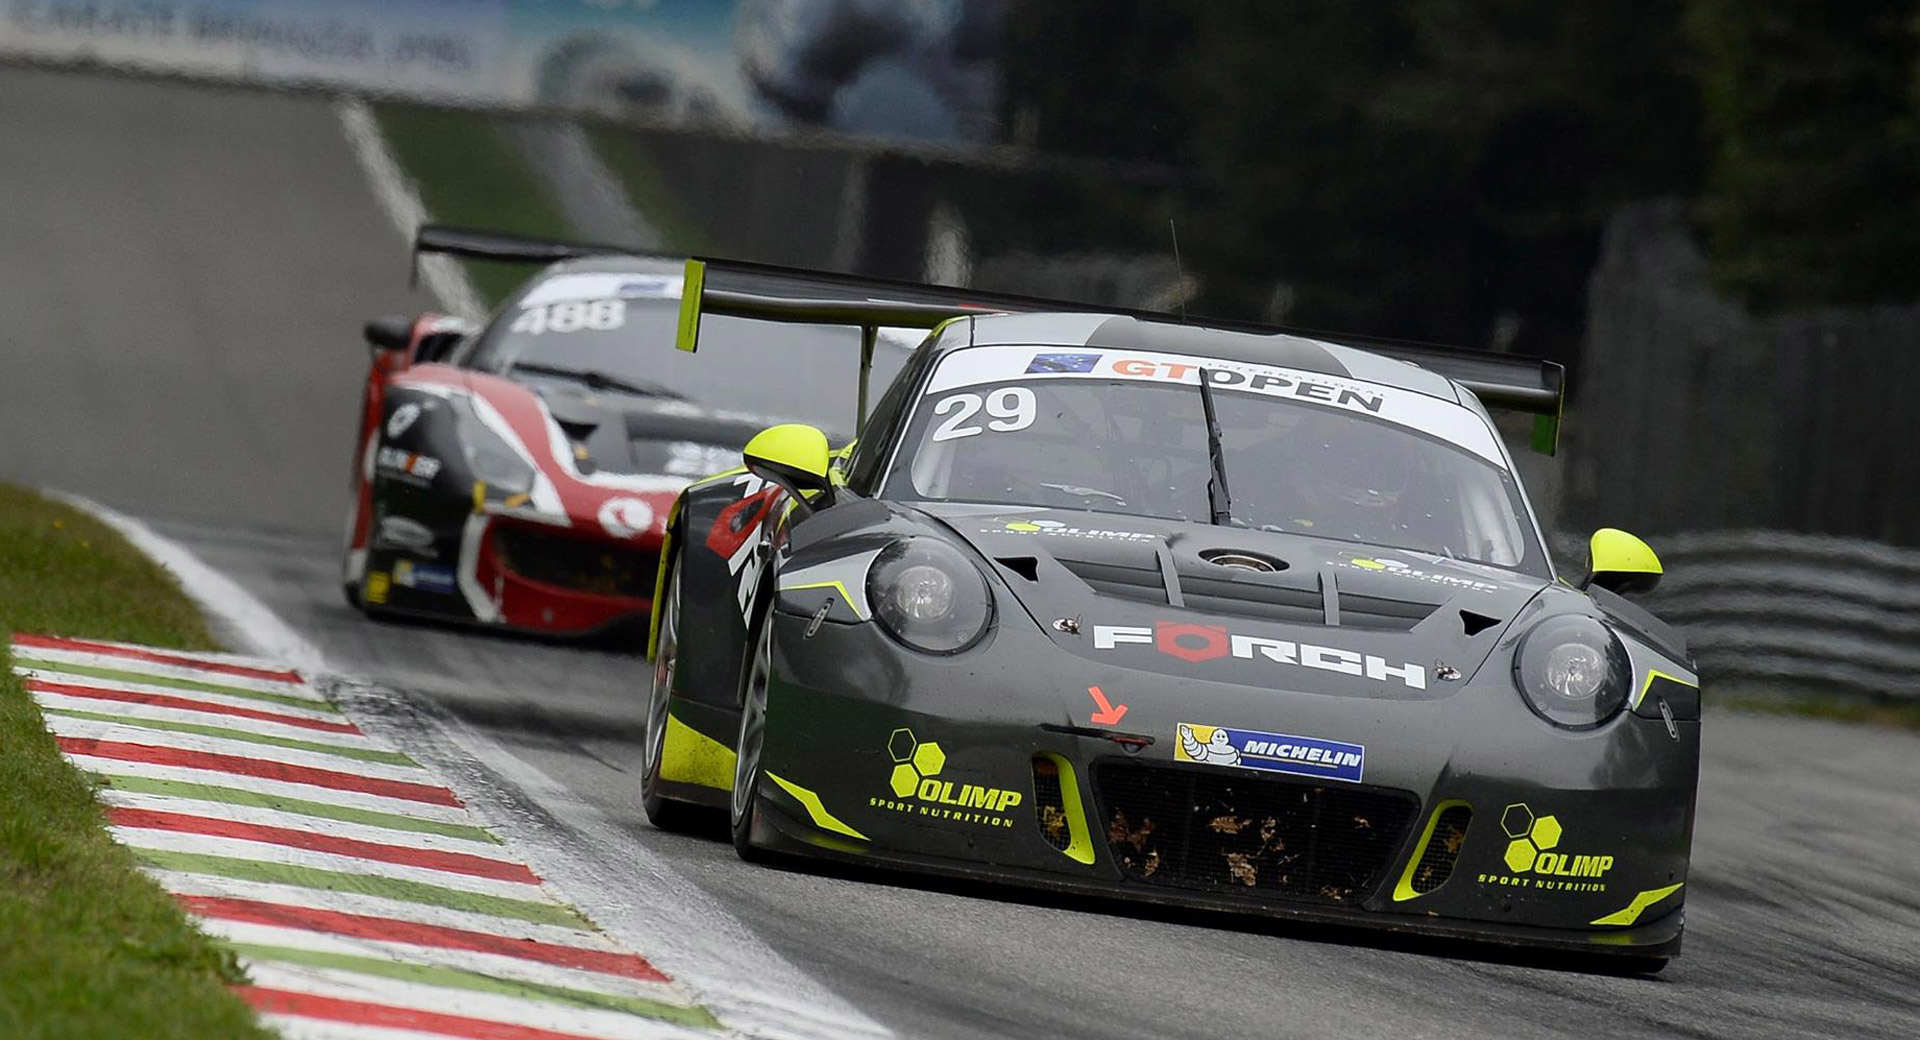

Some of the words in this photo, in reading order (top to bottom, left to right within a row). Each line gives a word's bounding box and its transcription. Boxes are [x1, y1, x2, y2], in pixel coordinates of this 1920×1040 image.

[510, 299, 626, 336] 488
[933, 387, 1037, 441] 29
[1042, 527, 1157, 540] OLIMP
[1387, 566, 1499, 590] OLIMP
[1243, 739, 1362, 768] MICHELIN
[917, 778, 1023, 813] OLIMP
[869, 796, 915, 814] SPORT
[919, 805, 1014, 829] NUTRITION
[1533, 851, 1615, 878] OLIMP
[1477, 873, 1531, 888] SPORT
[1535, 879, 1608, 893] NUTRITION
